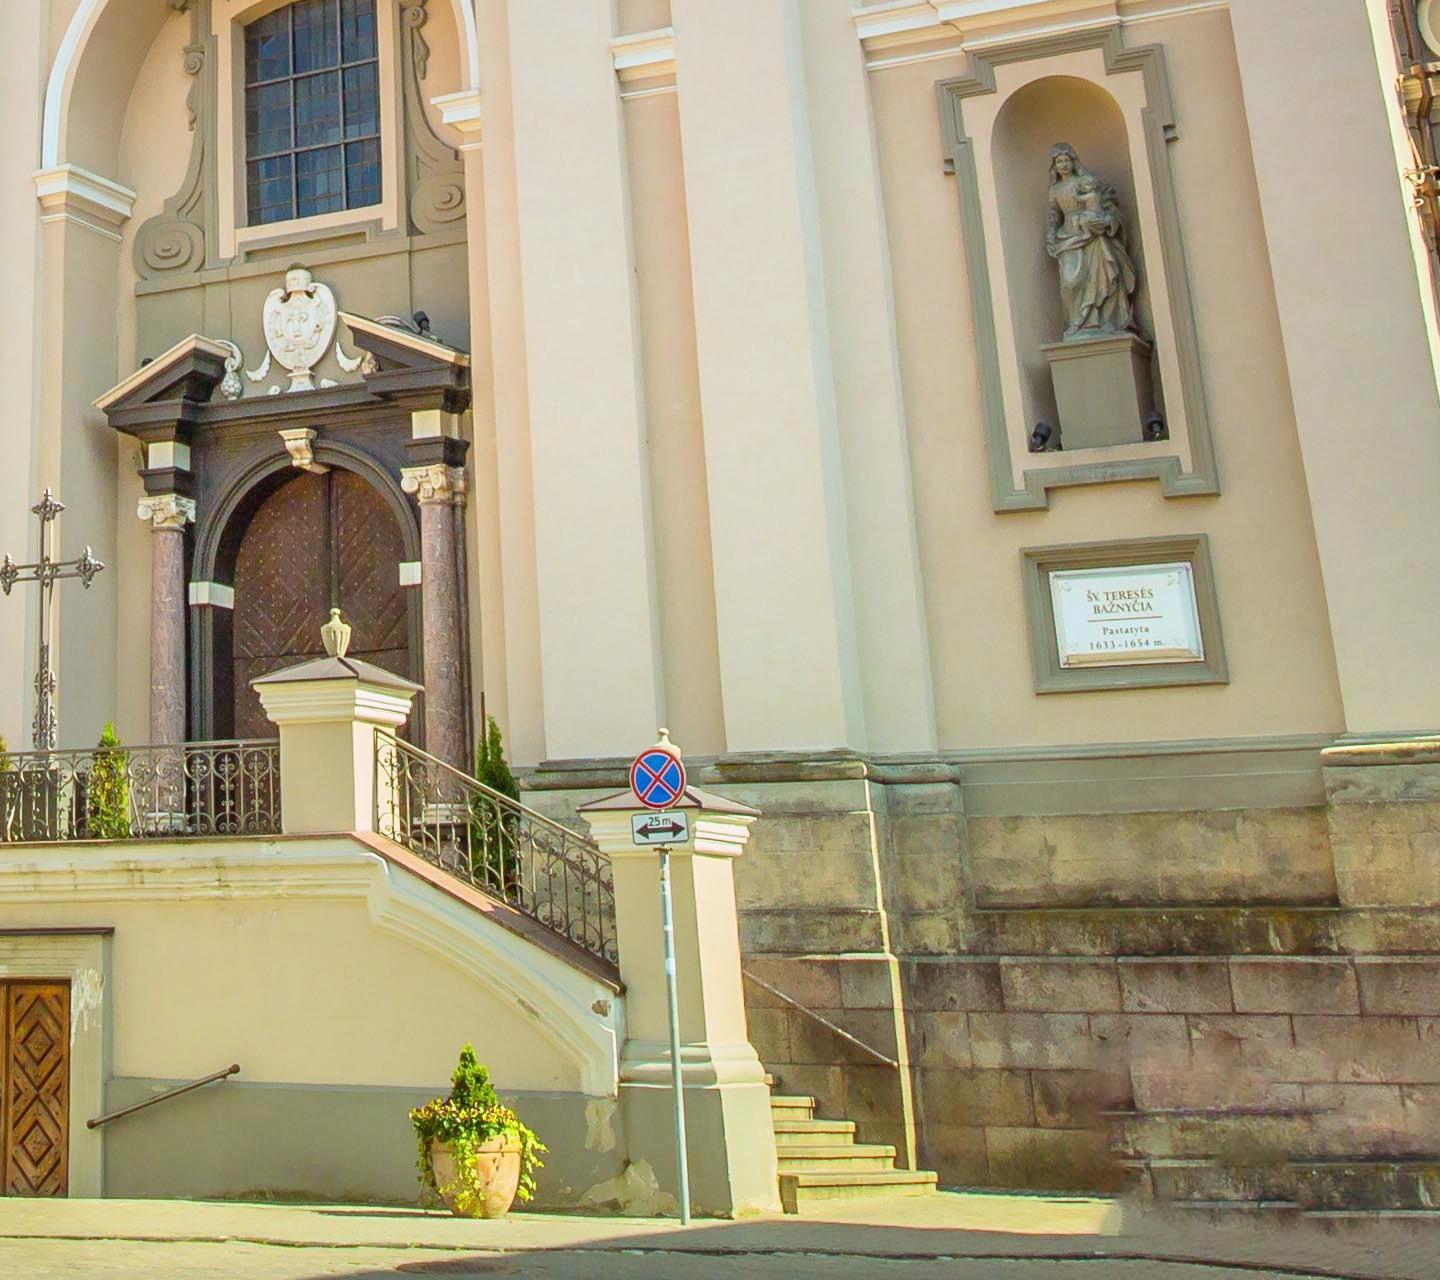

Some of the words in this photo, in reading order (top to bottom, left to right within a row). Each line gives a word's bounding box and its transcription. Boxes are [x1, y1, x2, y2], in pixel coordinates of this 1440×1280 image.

[1104, 588, 1154, 601] TERESĖS
[1093, 600, 1153, 615] BAŽNYČIA
[1102, 625, 1150, 636] Pastatyta
[648, 816, 661, 826] 25
[661, 818, 671, 826] m
